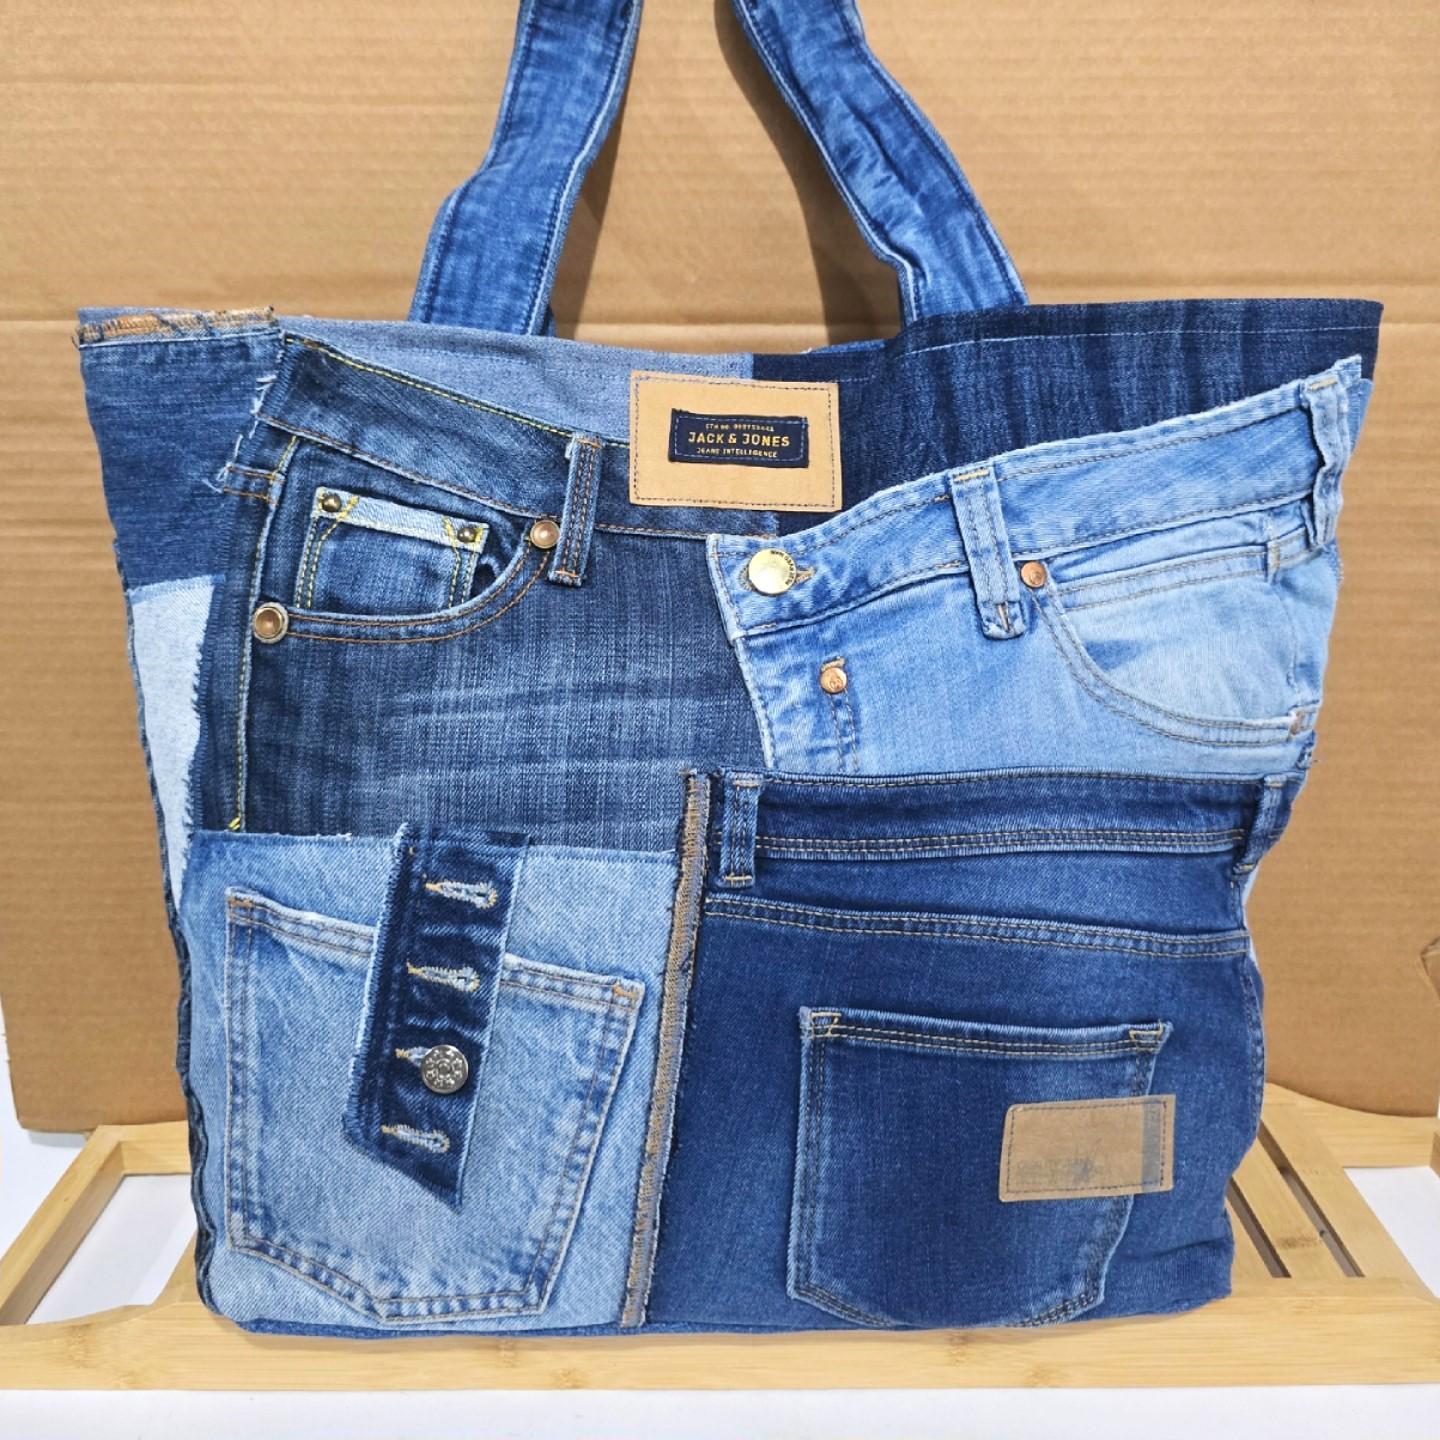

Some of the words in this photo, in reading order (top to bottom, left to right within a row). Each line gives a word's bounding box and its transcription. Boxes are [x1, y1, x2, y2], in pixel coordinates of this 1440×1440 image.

[688, 431, 724, 444] JACK
[728, 432, 737, 444] &
[742, 434, 790, 447] JONES
